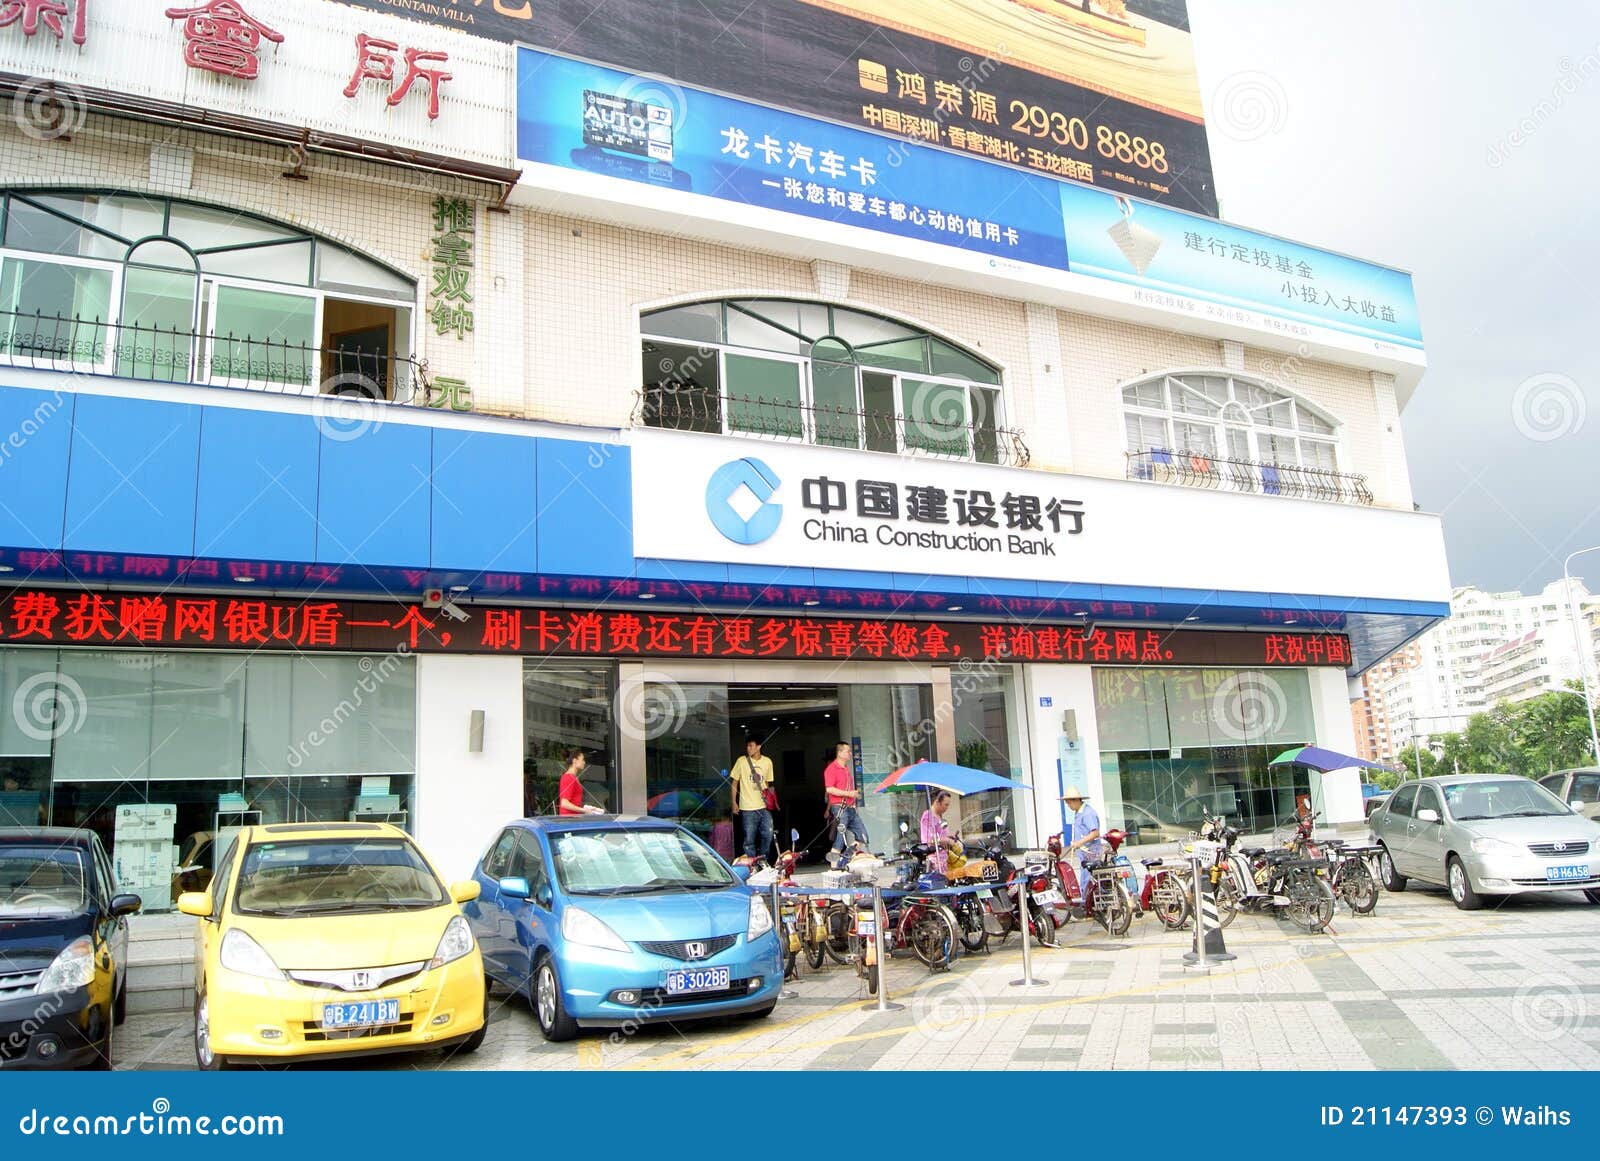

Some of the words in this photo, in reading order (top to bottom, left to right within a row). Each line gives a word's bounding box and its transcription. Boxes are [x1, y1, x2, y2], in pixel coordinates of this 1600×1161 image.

[377, 0, 439, 15] UNTAIN
[442, 7, 475, 24] VILLA
[584, 105, 645, 130] AUTO
[896, 68, 999, 126] 鸿荣源
[1009, 100, 1089, 151] 2930
[1096, 125, 1169, 174] 8888
[720, 126, 877, 186] 龙卡汽车卡
[761, 176, 1020, 246] 一张您和爱车都心动的信用卡
[1184, 231, 1315, 280] 建行定投基金
[1280, 280, 1399, 324] 小投入大收益
[429, 375, 473, 412] 元
[801, 475, 1085, 535] 中国建设银行
[803, 519, 868, 544] China
[876, 524, 1001, 552] Construction
[1007, 535, 1056, 557] Bank
